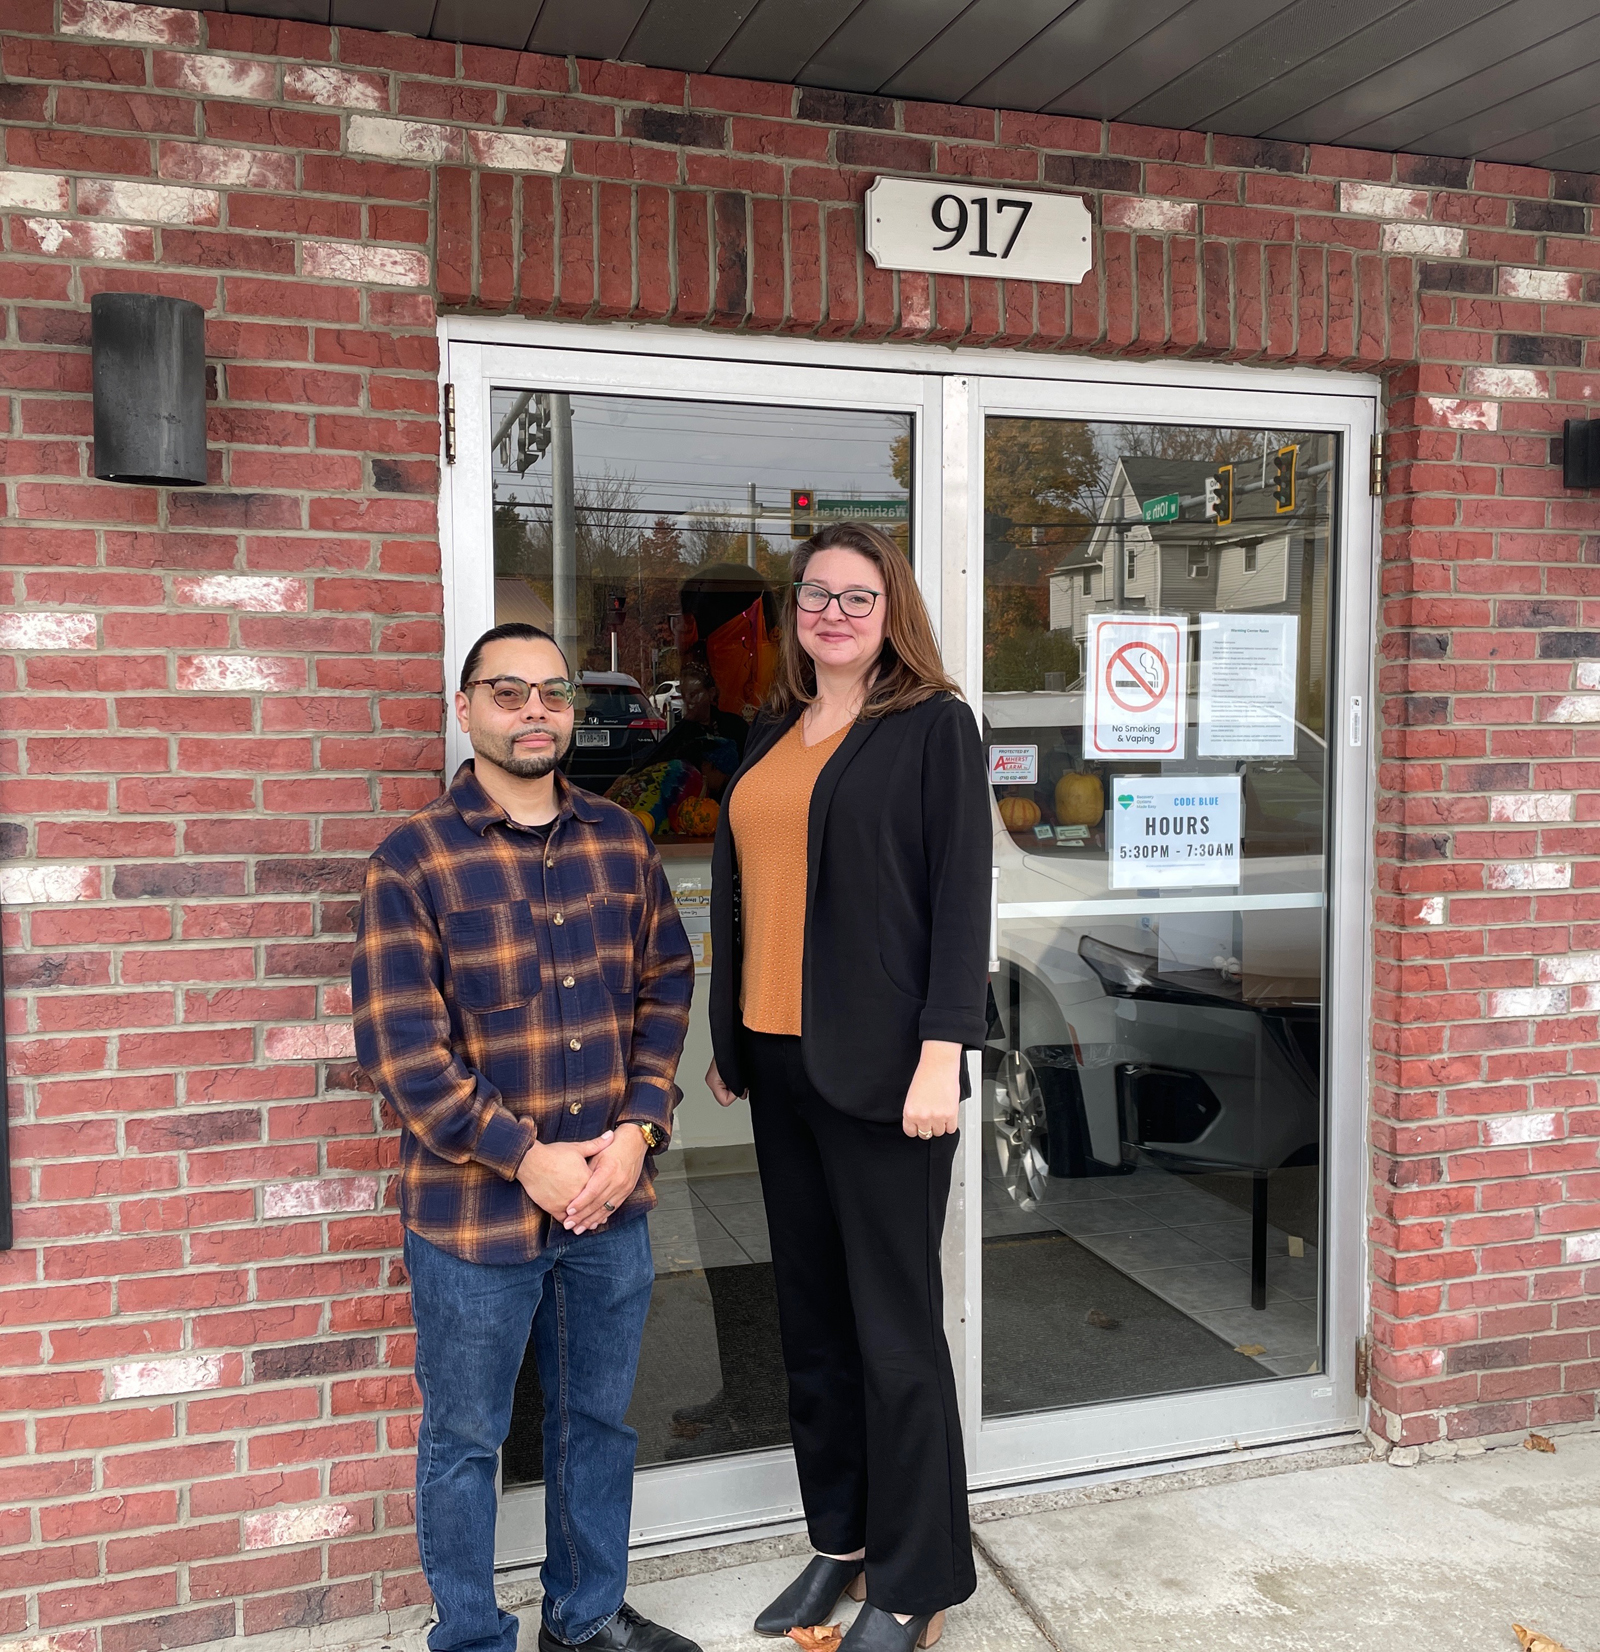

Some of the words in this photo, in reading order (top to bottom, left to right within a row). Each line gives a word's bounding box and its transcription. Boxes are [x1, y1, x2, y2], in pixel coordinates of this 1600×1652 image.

[931, 194, 1033, 259] 917
[1125, 725, 1160, 735] Smoking
[1126, 735, 1154, 744] Vaping
[1174, 797, 1195, 806] CODE
[1199, 797, 1219, 806] BLUE
[1145, 816, 1210, 836] HOURS
[1120, 845, 1169, 859] 5:30PM
[1187, 843, 1234, 857] 7:30AM
[699, 897, 709, 905] Day
